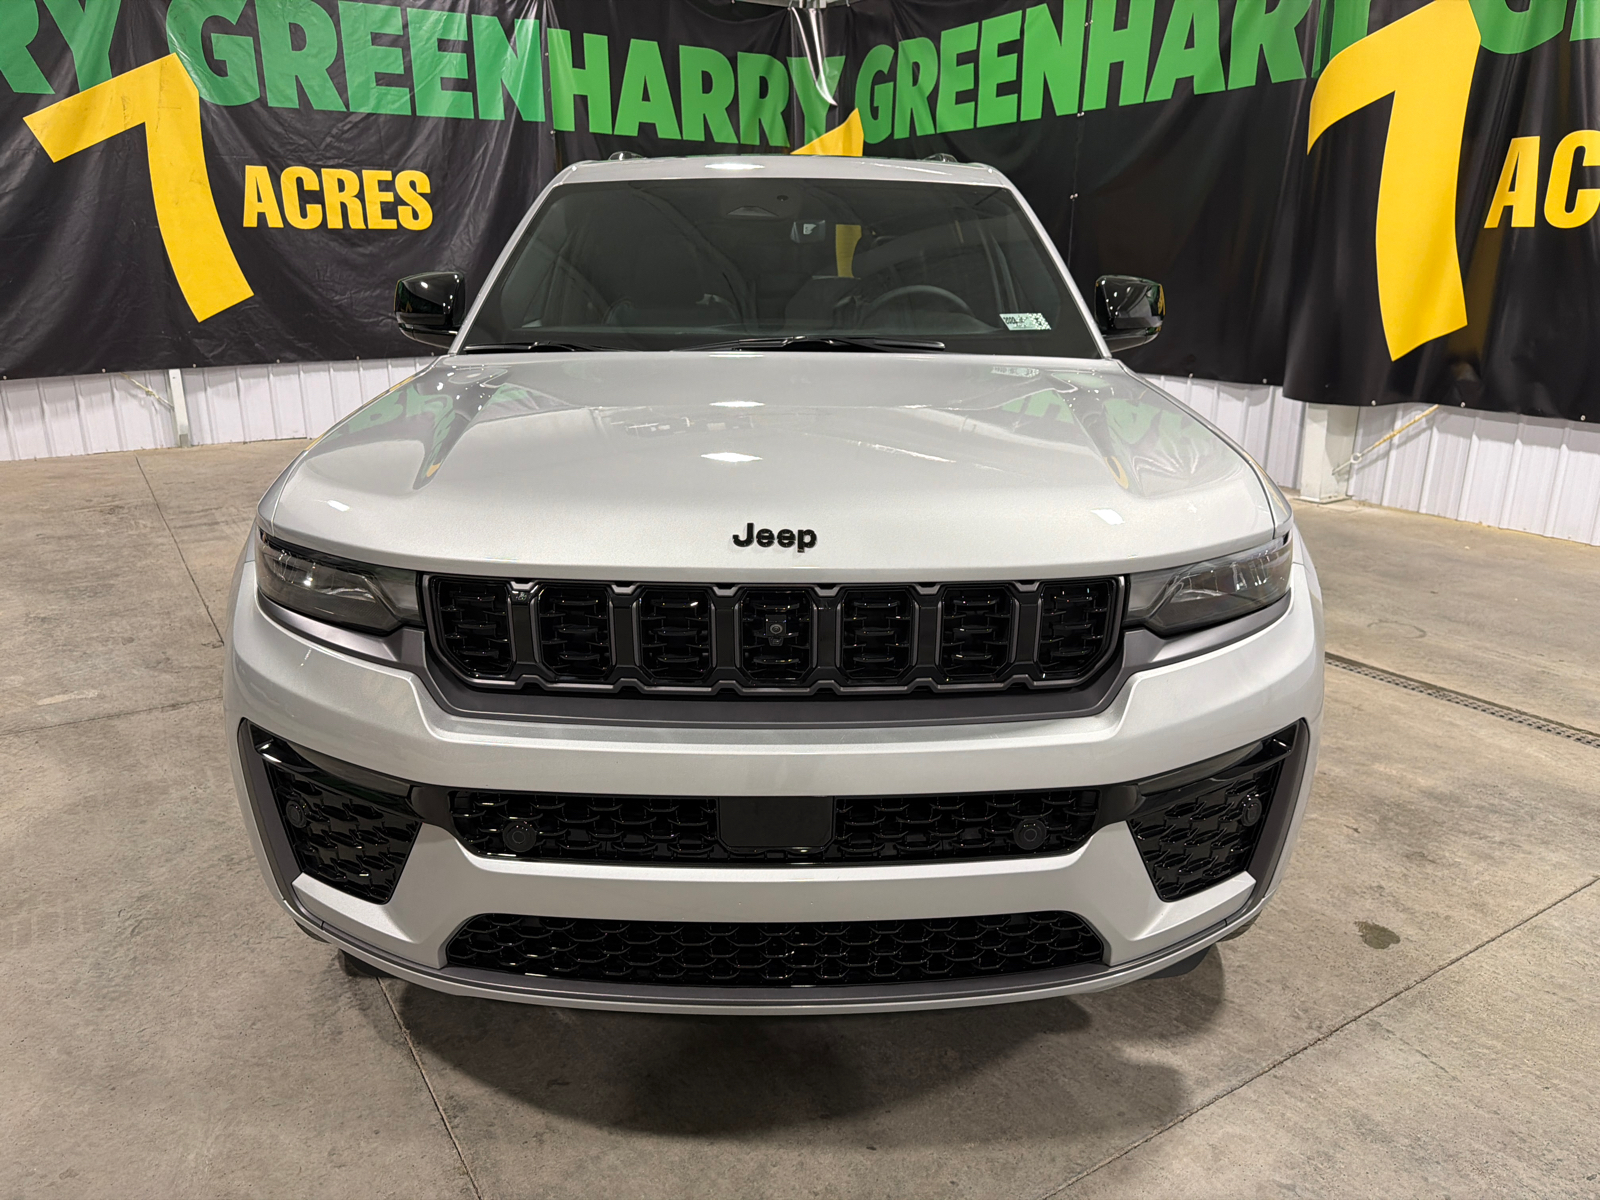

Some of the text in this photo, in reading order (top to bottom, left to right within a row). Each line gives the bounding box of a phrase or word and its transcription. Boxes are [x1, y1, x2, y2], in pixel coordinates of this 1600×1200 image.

[166, 0, 546, 122] GREEN
[548, 0, 1087, 147] HARRY GREEN
[23, 53, 254, 322] 7
[243, 165, 433, 231] ACRES
[1307, 0, 1481, 361] 7
[1484, 130, 1600, 229] AC
[732, 522, 818, 553] Jeep
